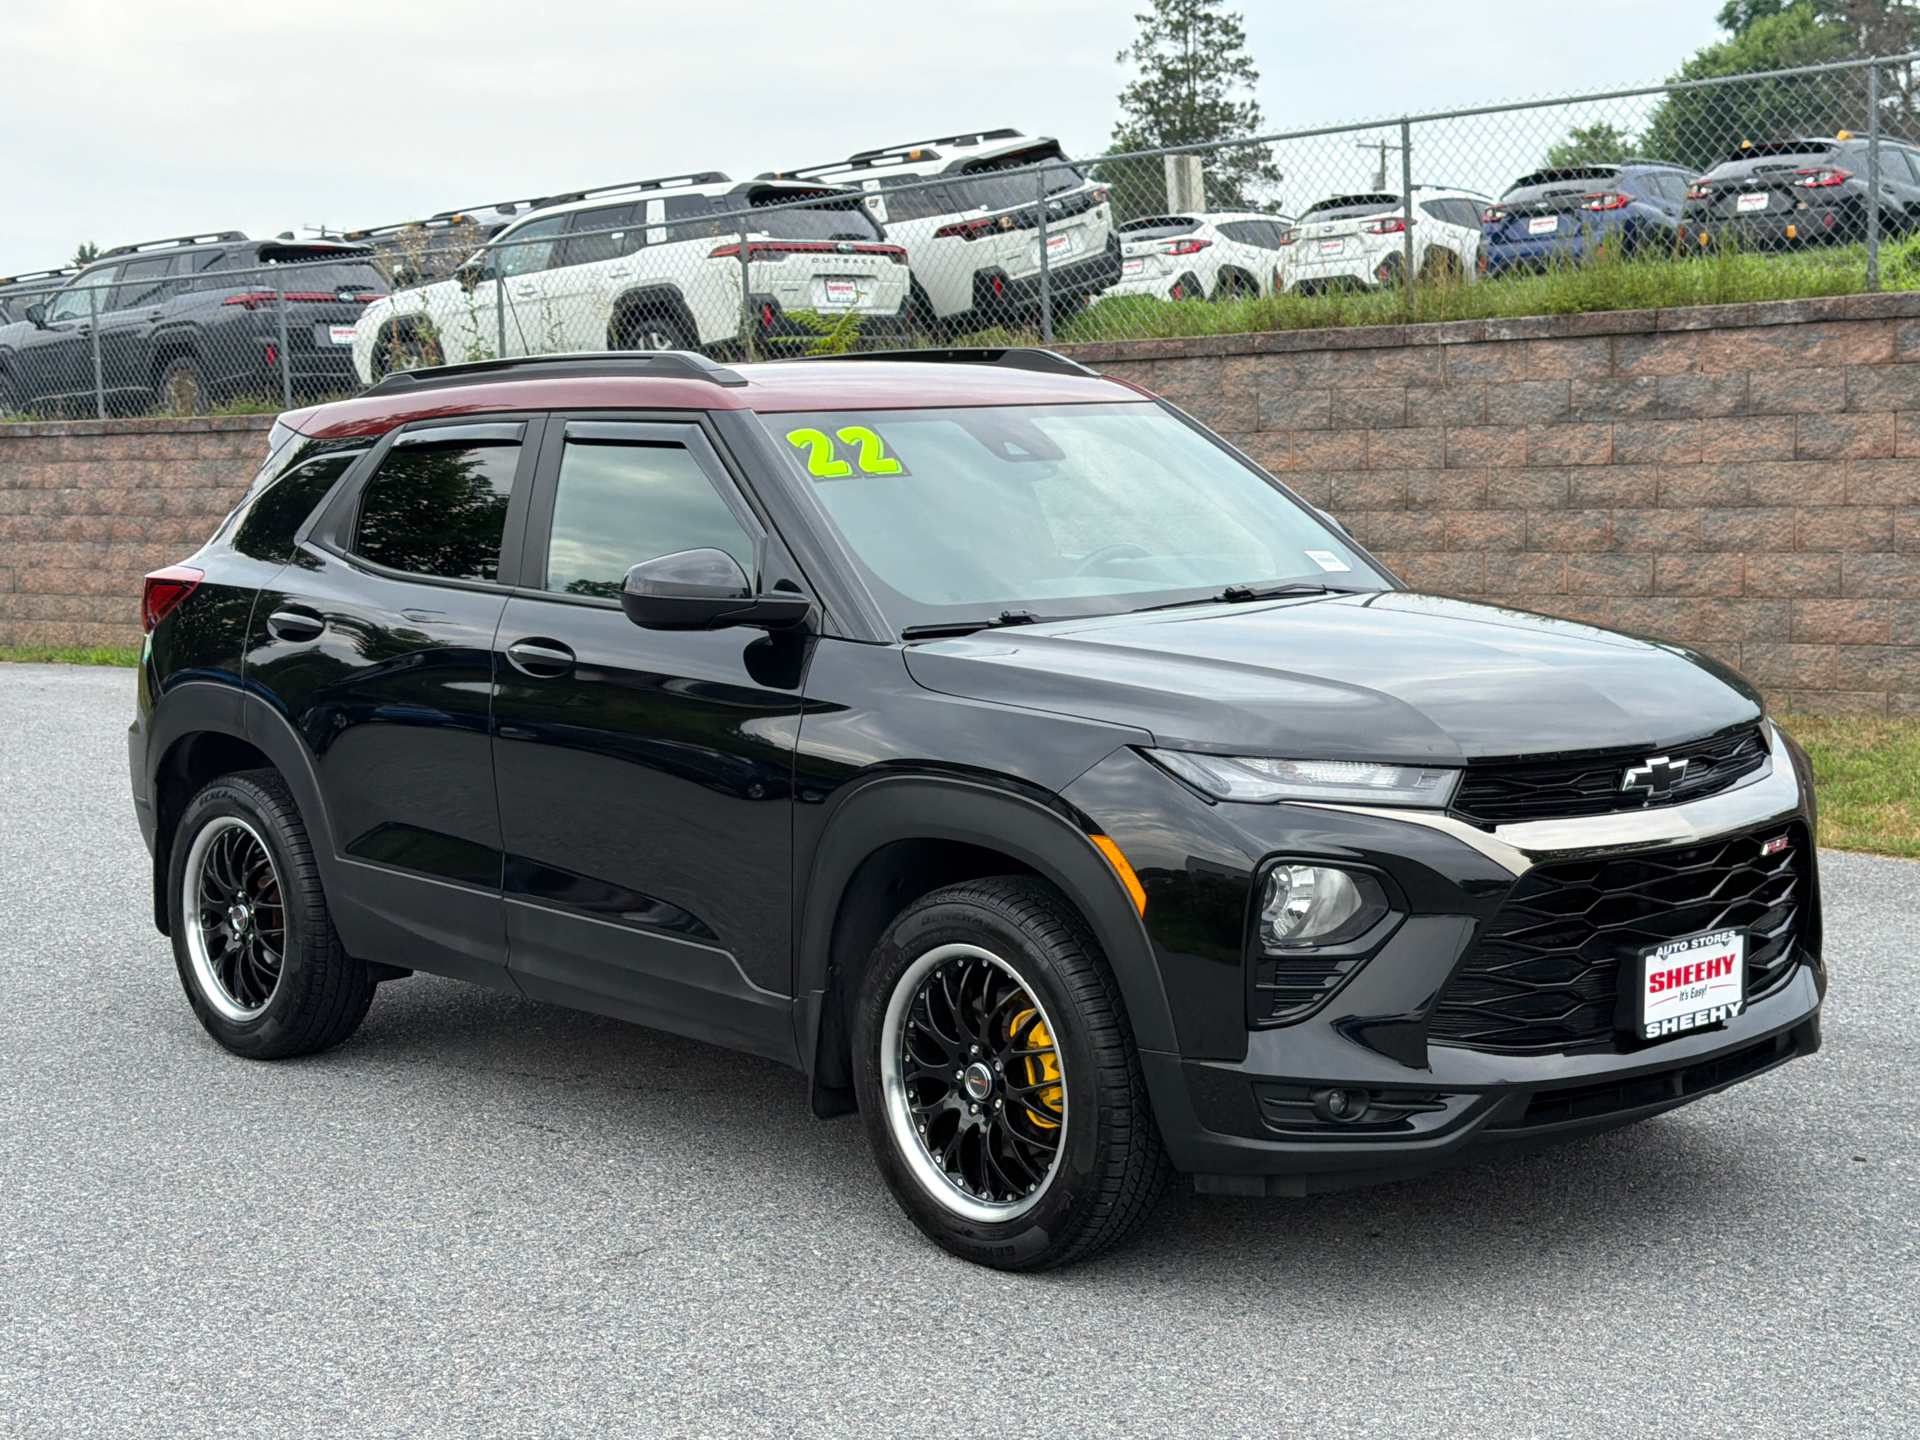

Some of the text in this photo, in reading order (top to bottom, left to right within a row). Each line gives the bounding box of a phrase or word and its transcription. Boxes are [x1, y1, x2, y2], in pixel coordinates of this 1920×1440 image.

[786, 426, 903, 478] 22
[1656, 930, 1736, 957] AUTO STORES
[1649, 953, 1736, 994] SHEEHY
[1679, 984, 1708, 1002] It's Easy!
[1646, 1001, 1743, 1039] SHEEHY
